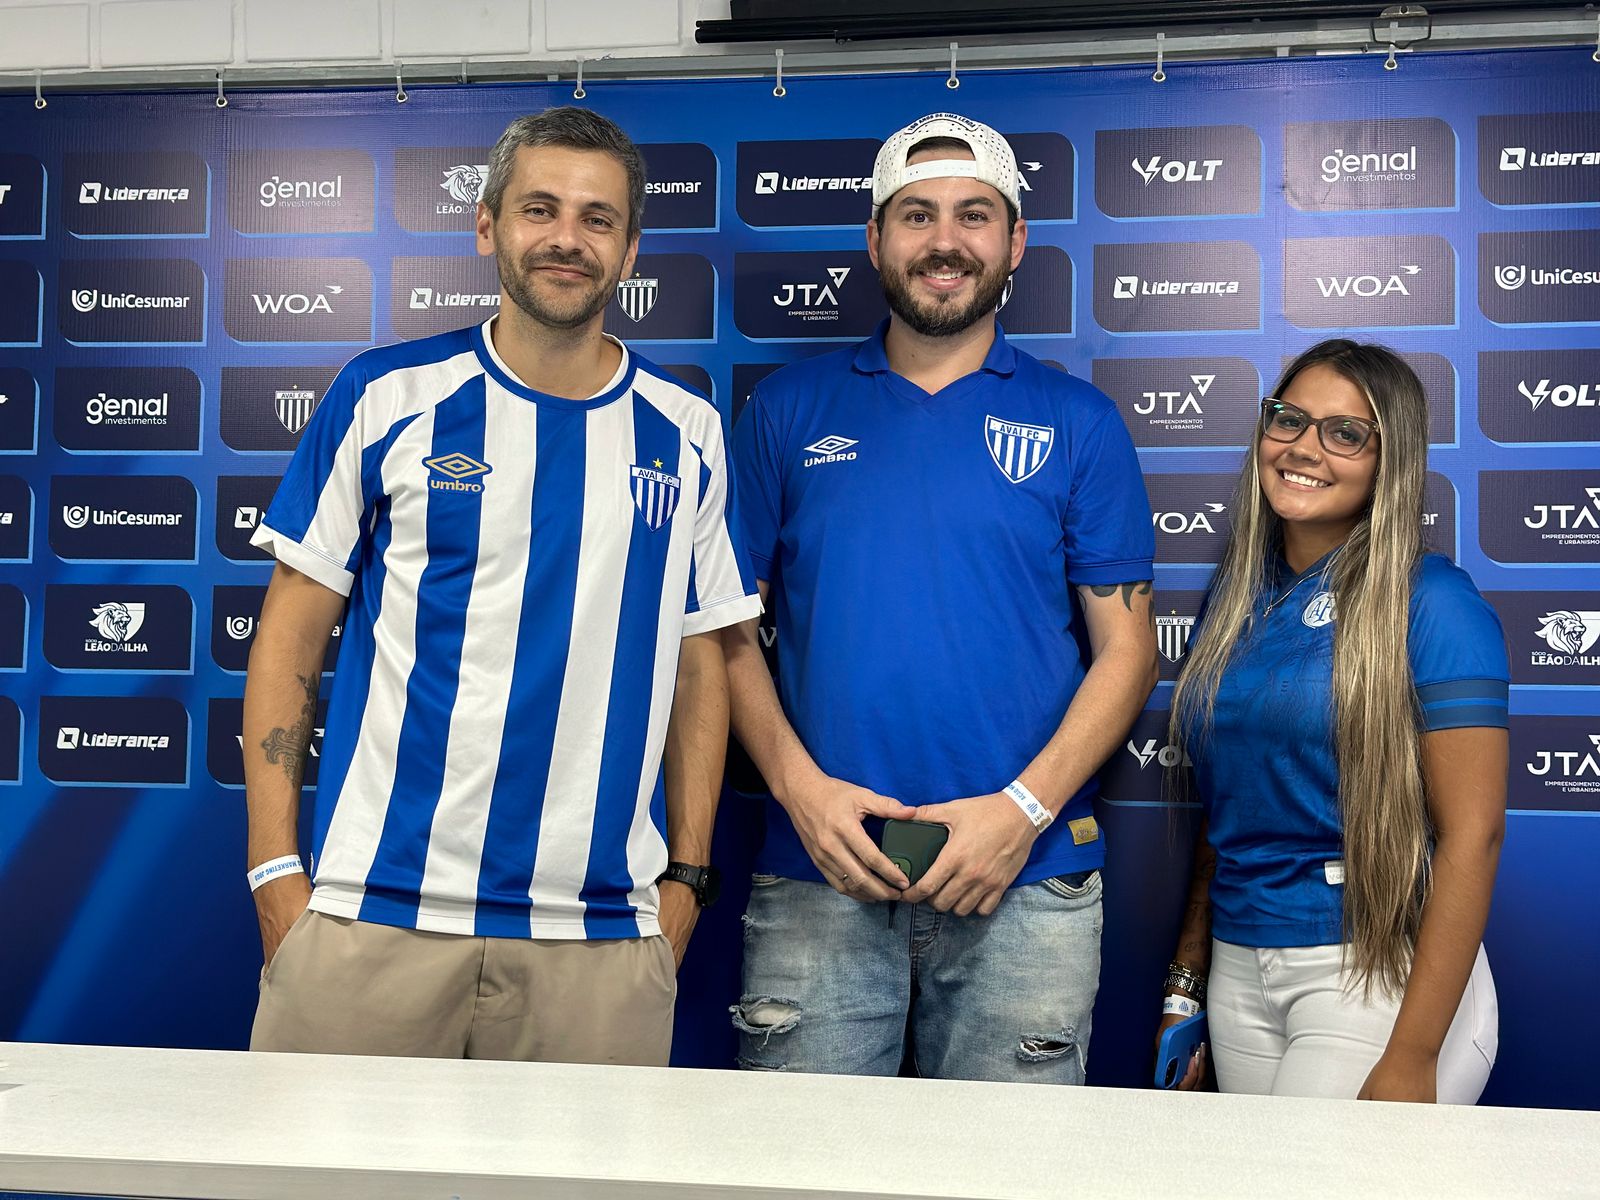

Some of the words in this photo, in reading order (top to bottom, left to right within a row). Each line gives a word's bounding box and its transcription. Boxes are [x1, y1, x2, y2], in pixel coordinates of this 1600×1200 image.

[1322, 146, 1416, 182] genial
[1530, 151, 1600, 167] Lidera
[1132, 156, 1223, 187] VOLT
[1344, 172, 1416, 182] investimentos
[260, 176, 342, 207] genial
[645, 181, 701, 194] esumar
[782, 176, 873, 192] Liderança
[104, 186, 189, 203] Liderança
[1531, 268, 1600, 285] UniCesu
[1142, 280, 1239, 296] Liderança
[1315, 275, 1410, 297] WOA
[101, 293, 190, 308] UniCesumar
[436, 292, 501, 306] Lideran
[774, 284, 838, 306] JTA
[252, 294, 334, 313] WOA
[1134, 392, 1203, 415] JTA
[1518, 379, 1600, 412] VOL
[86, 393, 168, 424] genial
[105, 416, 167, 425] investimentos
[1027, 429, 1039, 439] FC
[804, 452, 857, 467] UMBRO
[430, 480, 481, 492] umbro
[93, 510, 182, 525] UniCesumar
[1524, 505, 1600, 528] JTA
[1532, 654, 1600, 666] LEÃODAILH
[82, 732, 169, 751] Liderança
[1526, 752, 1600, 776] JTA
[265, 860, 297, 876] MARKETING
